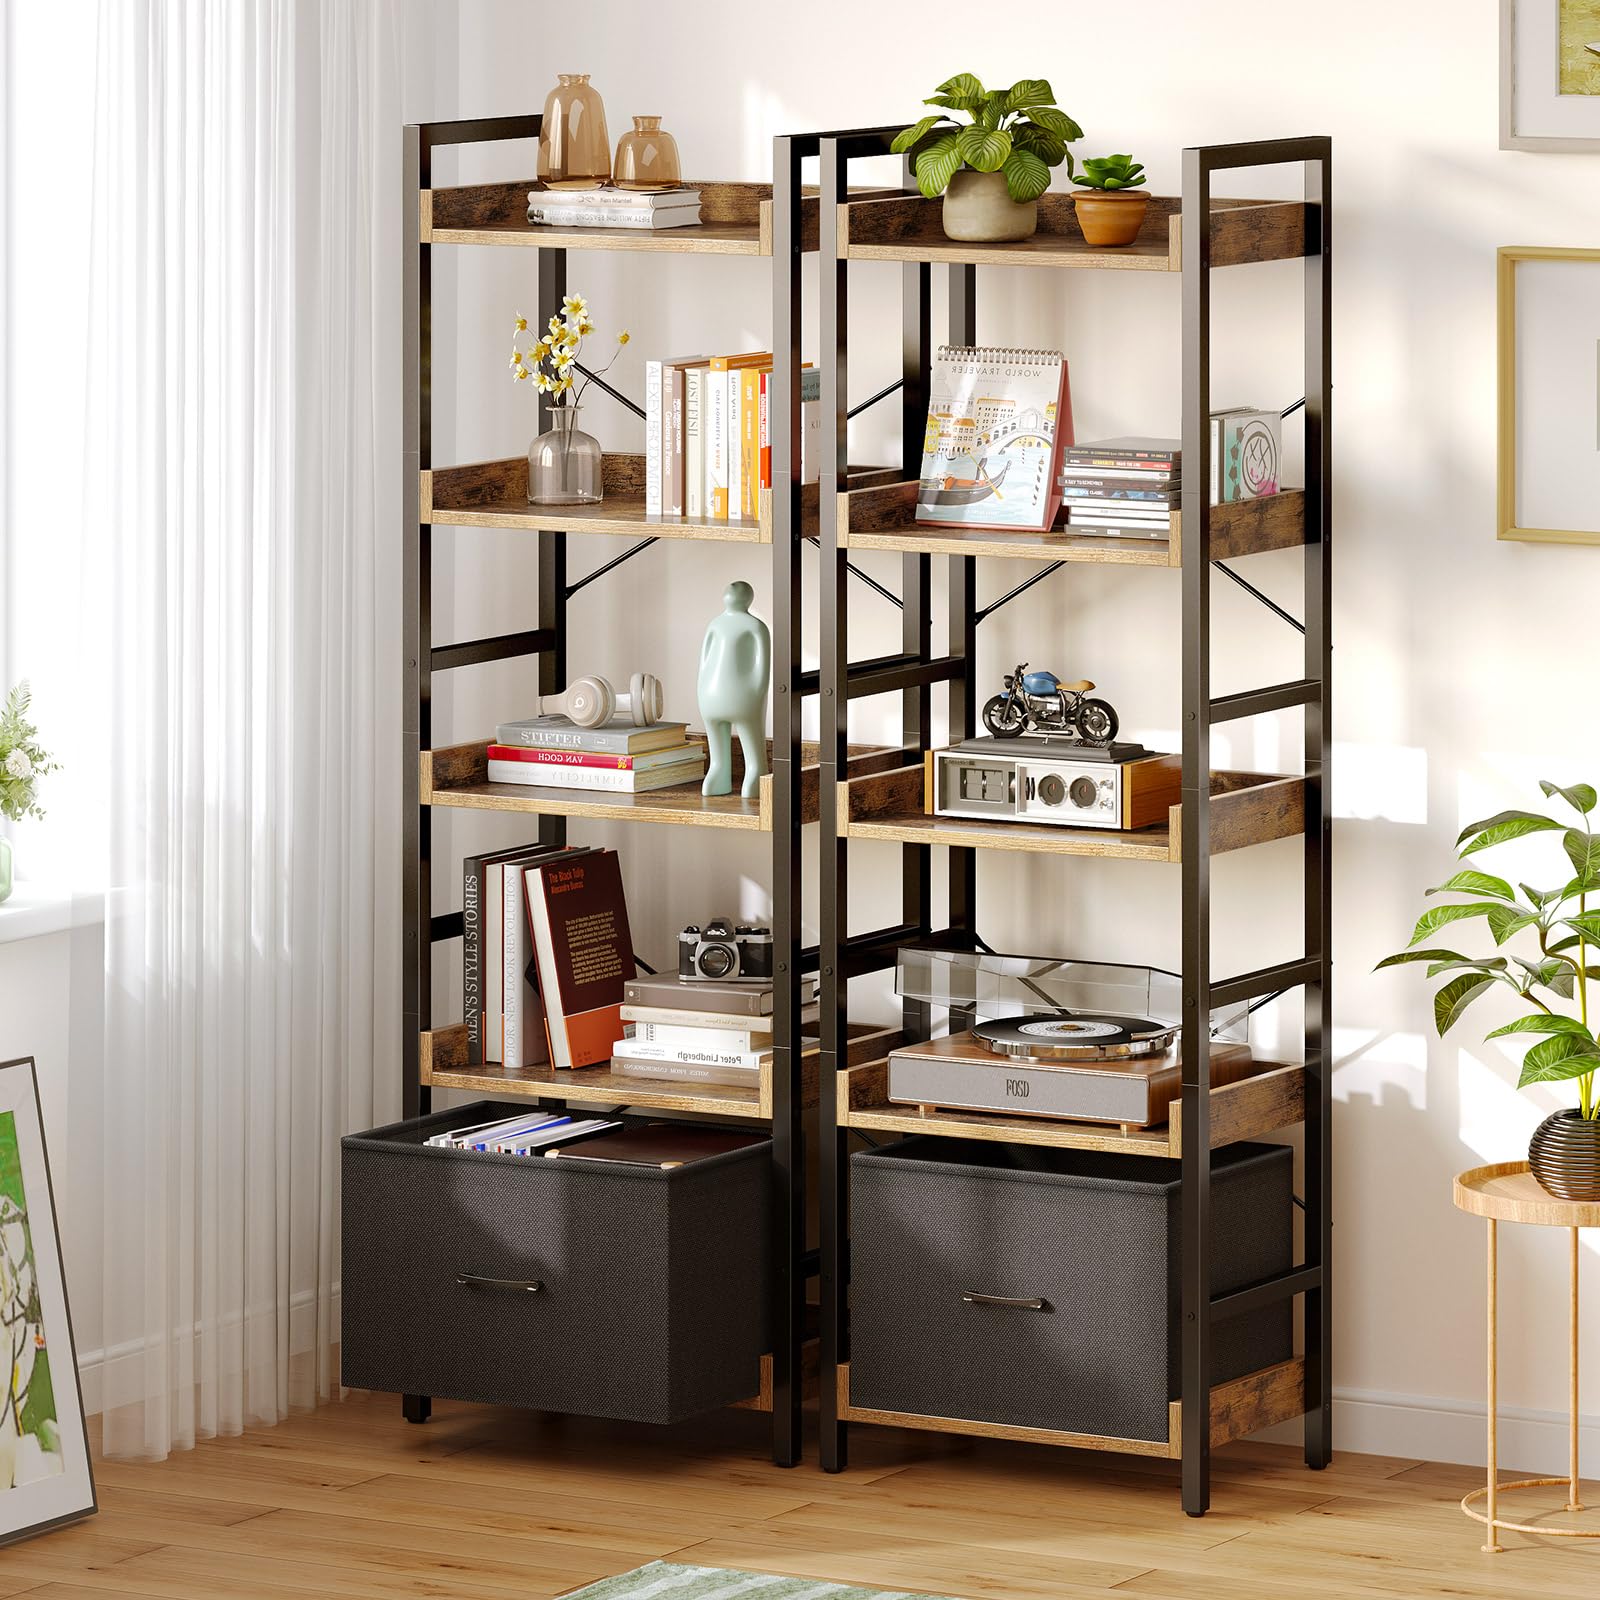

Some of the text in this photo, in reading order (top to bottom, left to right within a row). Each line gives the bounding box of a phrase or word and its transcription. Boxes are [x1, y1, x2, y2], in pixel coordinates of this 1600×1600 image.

[648, 366, 659, 414] ALEXEY
[688, 374, 698, 437] LOST FISH
[520, 731, 582, 745] STIFTER
[506, 876, 515, 954] REVOLUTION
[466, 875, 478, 1044] MEN'S STYLE STORIES
[506, 958, 515, 992] LOOK
[506, 996, 515, 1022] NEW
[1006, 1078, 1030, 1098] FOSD
